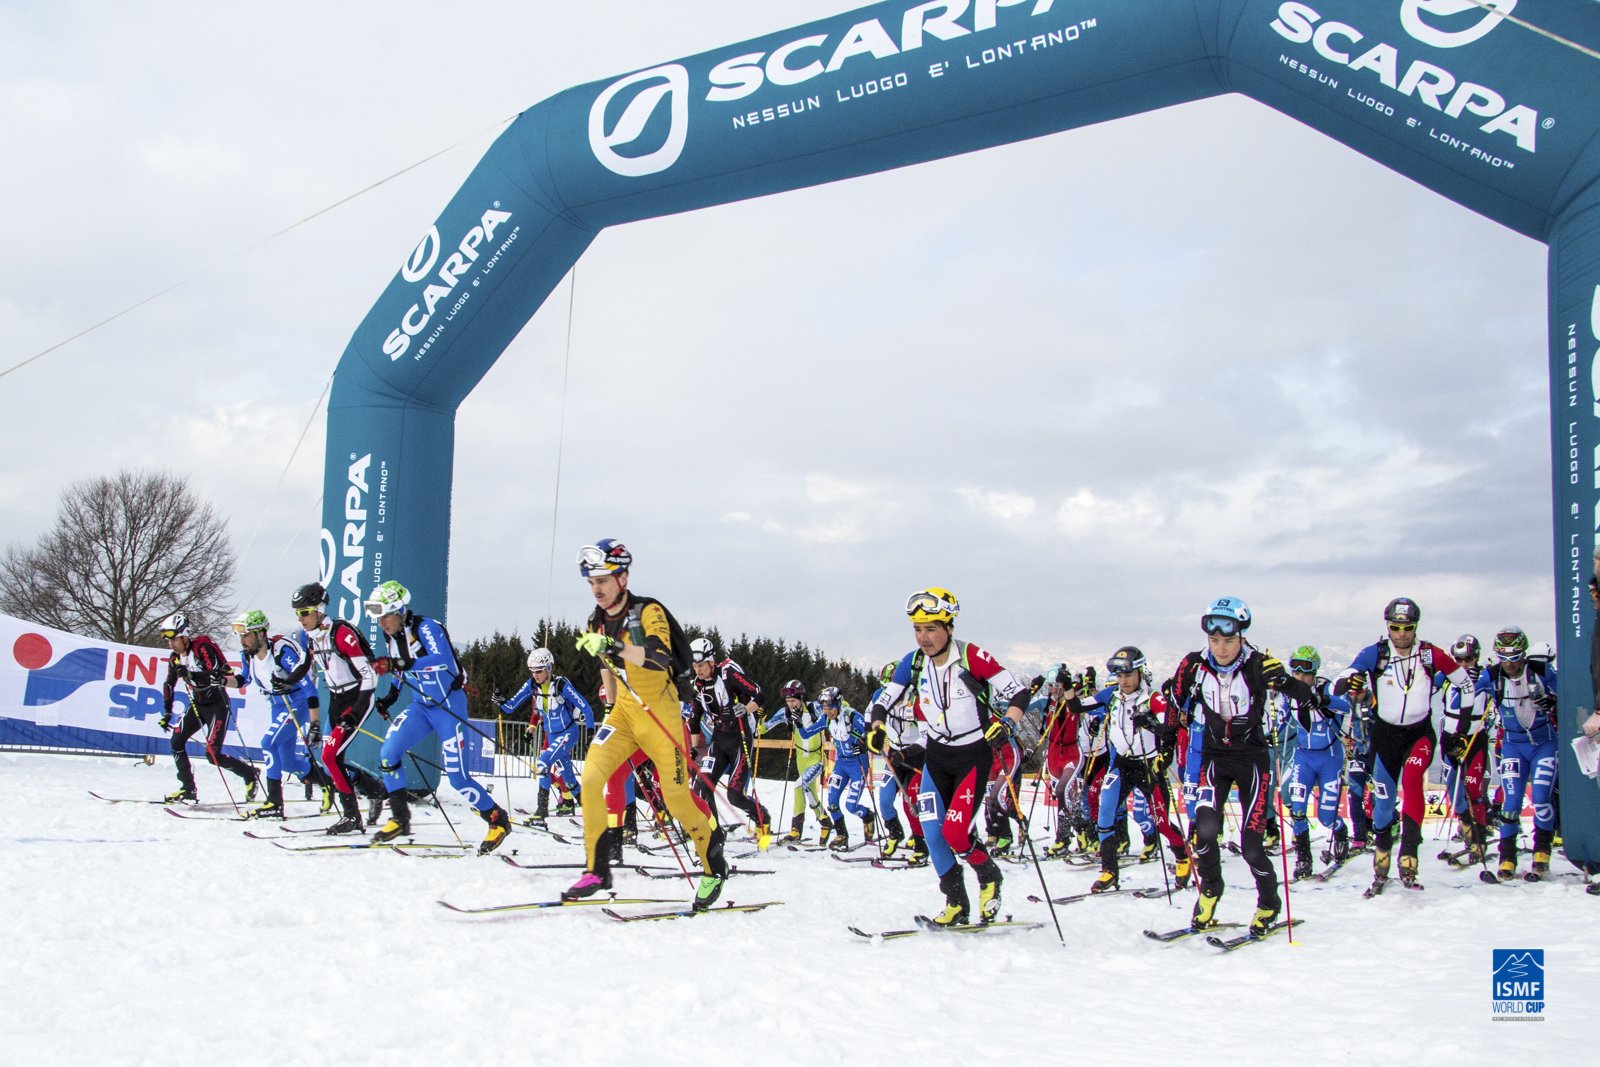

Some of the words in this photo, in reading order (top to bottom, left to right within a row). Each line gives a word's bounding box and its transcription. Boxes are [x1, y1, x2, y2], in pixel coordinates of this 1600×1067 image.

[705, 0, 1056, 101] SCAR
[732, 97, 820, 129] NESSUN
[837, 73, 908, 102] LUOGO
[1279, 54, 1338, 89] NESSUN
[1347, 88, 1394, 116] LUOGO
[414, 324, 445, 361] NESSUN
[446, 292, 470, 321] LUOGO
[1568, 323, 1577, 407] NESSUN
[1569, 421, 1578, 484] LUOGO
[109, 684, 246, 731] SPOT
[442, 736, 460, 773] ITA
[1533, 757, 1555, 786] ITA
[846, 780, 861, 803] ITA
[1247, 772, 1270, 831] KARPOS
[1320, 779, 1338, 811] ITA
